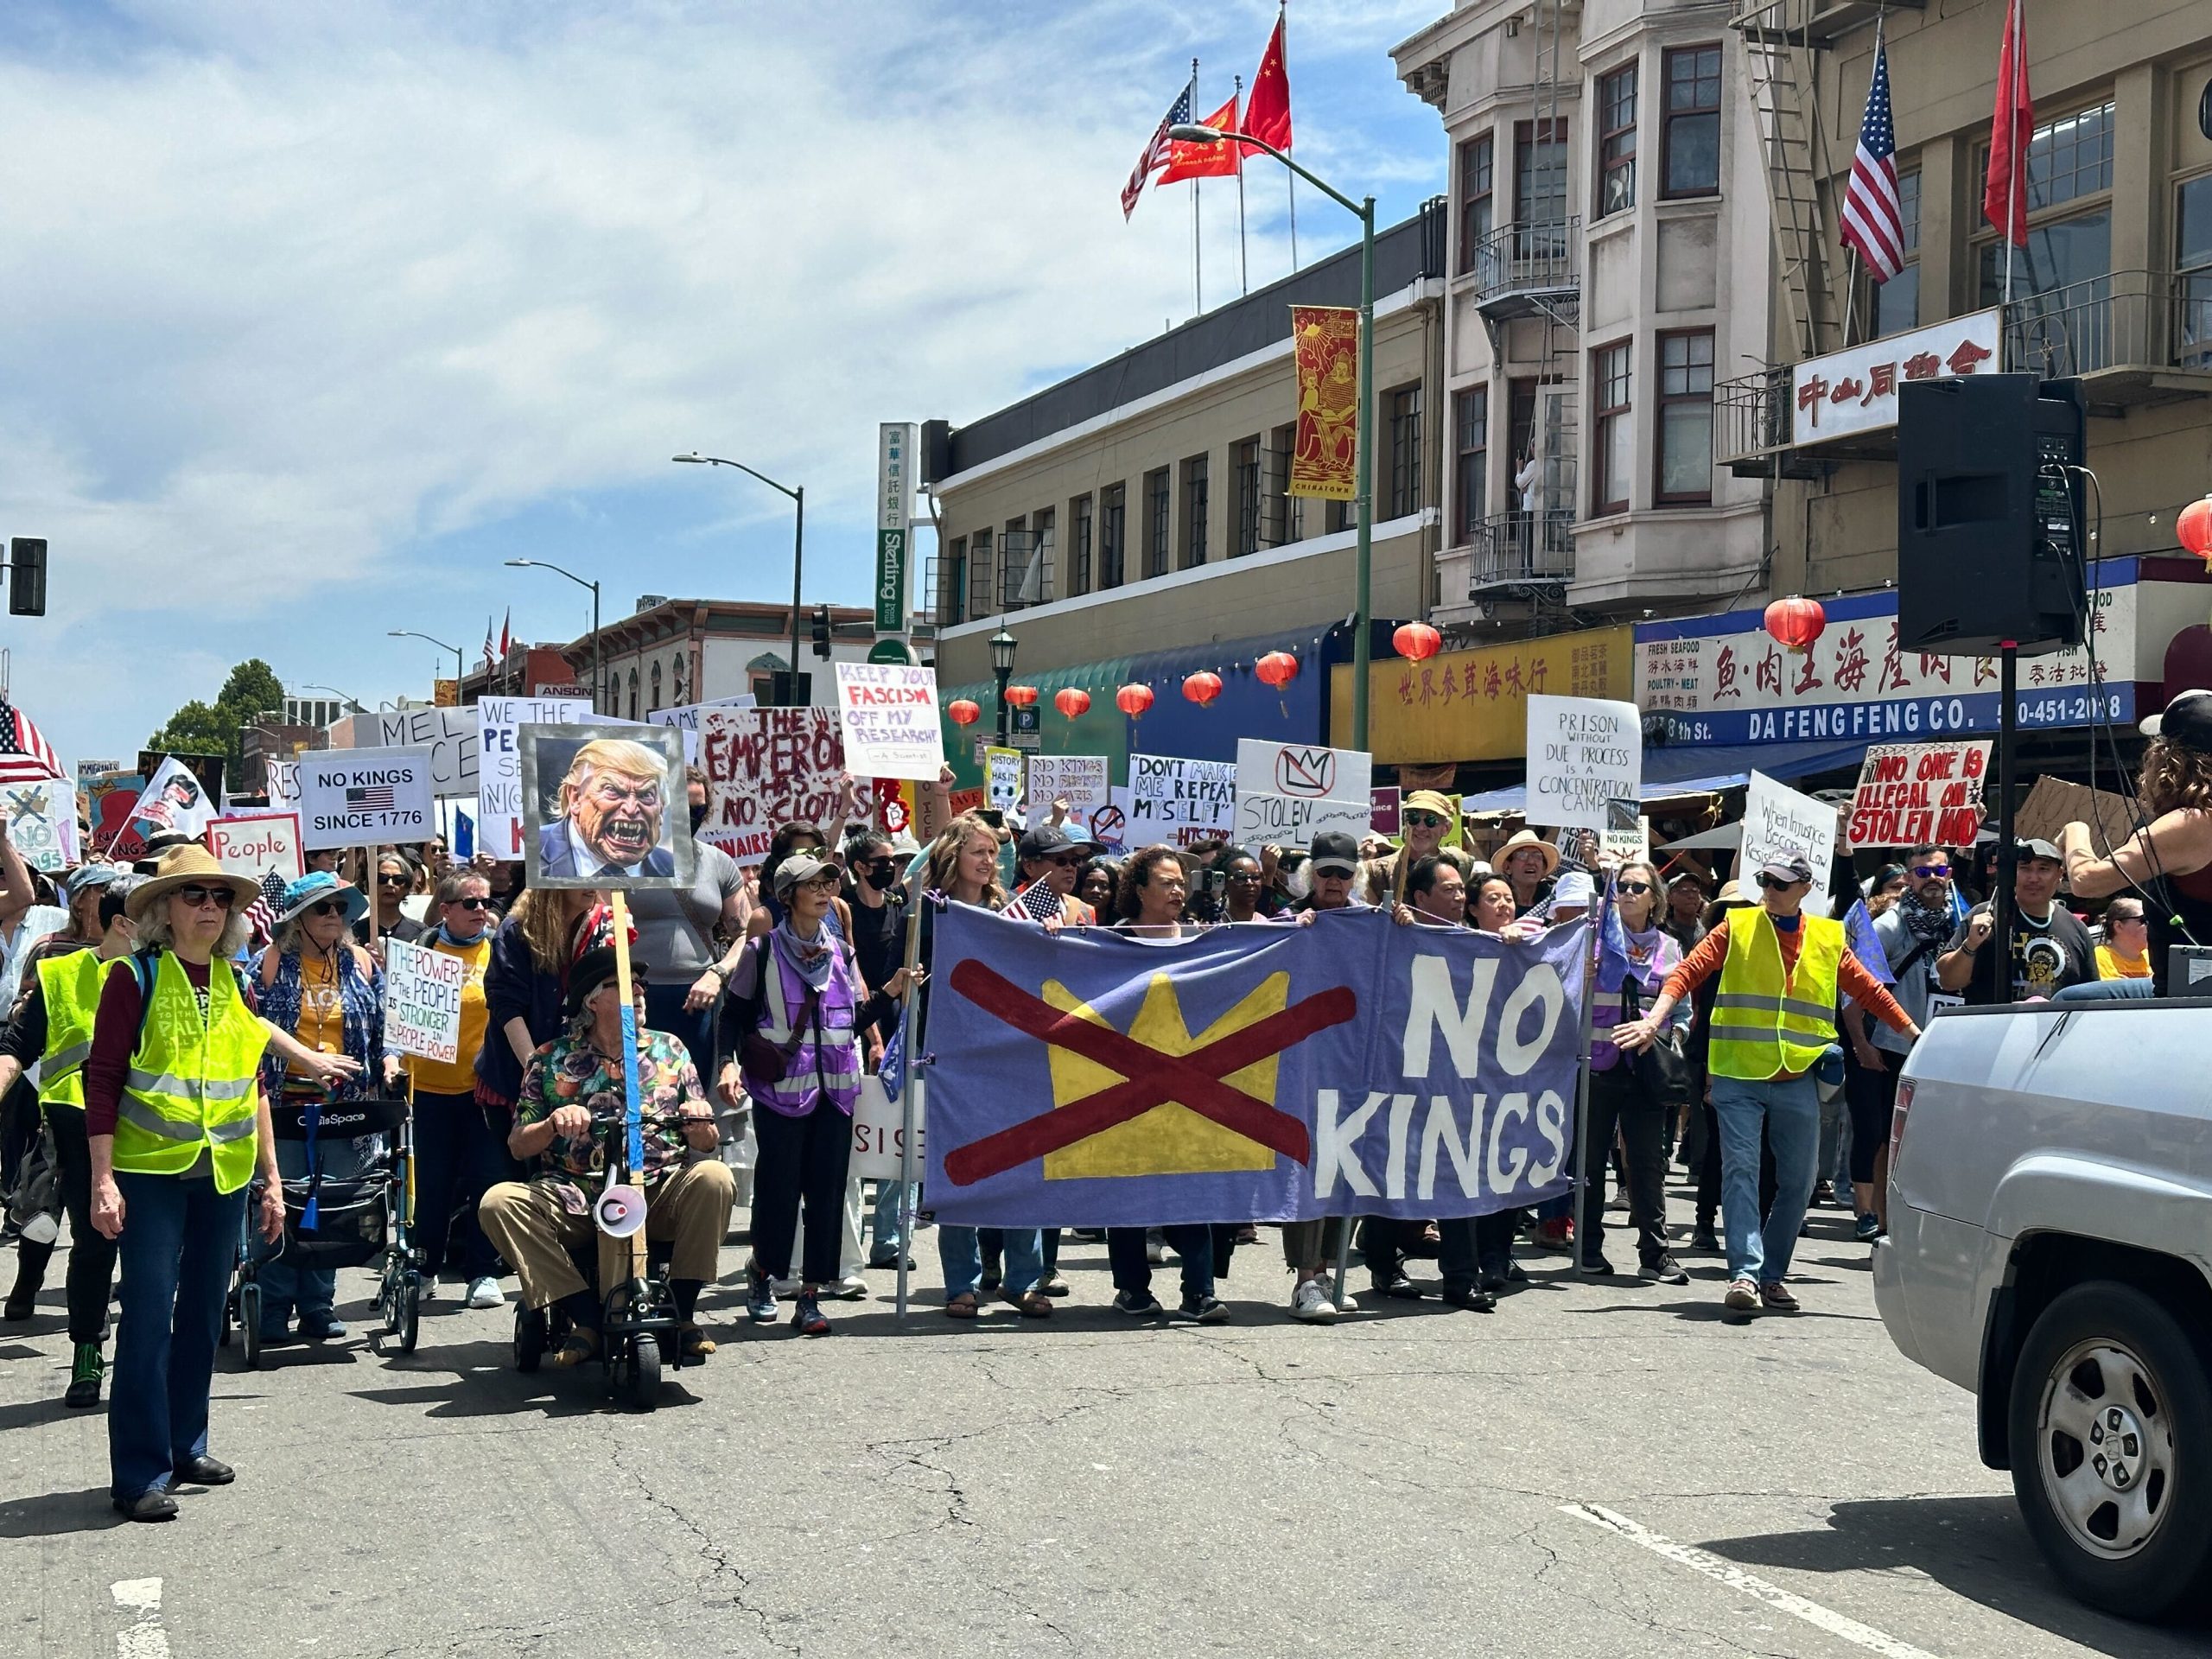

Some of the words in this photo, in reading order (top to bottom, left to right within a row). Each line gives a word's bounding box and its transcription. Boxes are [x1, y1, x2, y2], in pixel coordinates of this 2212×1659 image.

[1295, 483, 1349, 493] CHINATOWN
[880, 532, 900, 601] Sterling
[1648, 642, 1668, 656] FRESH
[1670, 640, 1700, 653] SEAFOOD
[839, 664, 889, 683] KEEP
[1648, 677, 1675, 691] POULTRY
[1681, 678, 1699, 690] MEAT
[848, 686, 931, 705] FASCISM
[483, 701, 515, 723] WE
[528, 702, 573, 724] THE
[750, 708, 807, 734] THE
[847, 710, 878, 726] OFF
[887, 709, 912, 725] MY
[1559, 713, 1618, 733] PRISON
[1749, 713, 1776, 741] DA
[1784, 707, 1846, 738] FENG
[1853, 702, 1920, 734] FENG
[1929, 698, 1975, 731] CO.
[1567, 732, 1612, 743] WITHOUT
[1694, 722, 1712, 740] St.
[991, 755, 1020, 766] HISTORY
[1547, 744, 1570, 762] DUE
[1582, 747, 1630, 766] PROCESS
[1876, 755, 1909, 783] NO
[1916, 751, 1959, 781] ONE
[1961, 747, 1983, 779] IS
[318, 772, 347, 787] NO
[353, 769, 413, 785] KINGS
[992, 772, 1005, 782] HAS
[1007, 773, 1019, 783] ITS
[1033, 760, 1054, 772] NO
[1059, 760, 1103, 774] KINGS
[1586, 766, 1593, 774] A
[760, 774, 810, 798] HAS
[1033, 774, 1054, 788] NO
[1135, 776, 1164, 797] ME
[1175, 779, 1236, 803] REPEAT
[1539, 775, 1633, 798] CONCENTRATION
[768, 785, 873, 824] CLOTHS
[1033, 789, 1054, 803] NO
[1562, 794, 1607, 812] CAMP
[1856, 781, 1930, 810] ILLEGAL
[1940, 780, 1967, 807] ON
[315, 813, 373, 830] SINCE
[378, 810, 423, 828] 1776
[722, 796, 756, 826] NO
[1243, 797, 1313, 830] STOLEN
[1761, 796, 1788, 829] When
[1789, 810, 1826, 845] Injustice
[15, 824, 52, 847] NO
[1848, 809, 1934, 844] STOLEN
[215, 831, 286, 866] People
[1607, 835, 1618, 843] NO
[1619, 835, 1643, 844] KINGS
[1808, 842, 1828, 868] Law
[392, 943, 416, 974] THE
[415, 950, 460, 985] POWER
[390, 971, 400, 986] OF
[398, 982, 410, 999] THE
[413, 977, 460, 1014] PEOPLE
[388, 996, 397, 1010] IS
[399, 1001, 449, 1033] STRONGER
[1402, 954, 1565, 1079] NO
[397, 1024, 426, 1051] PEOPLE
[432, 1031, 442, 1041] IN
[427, 1040, 456, 1060] POWER
[1313, 1088, 1566, 1200] KINGS
